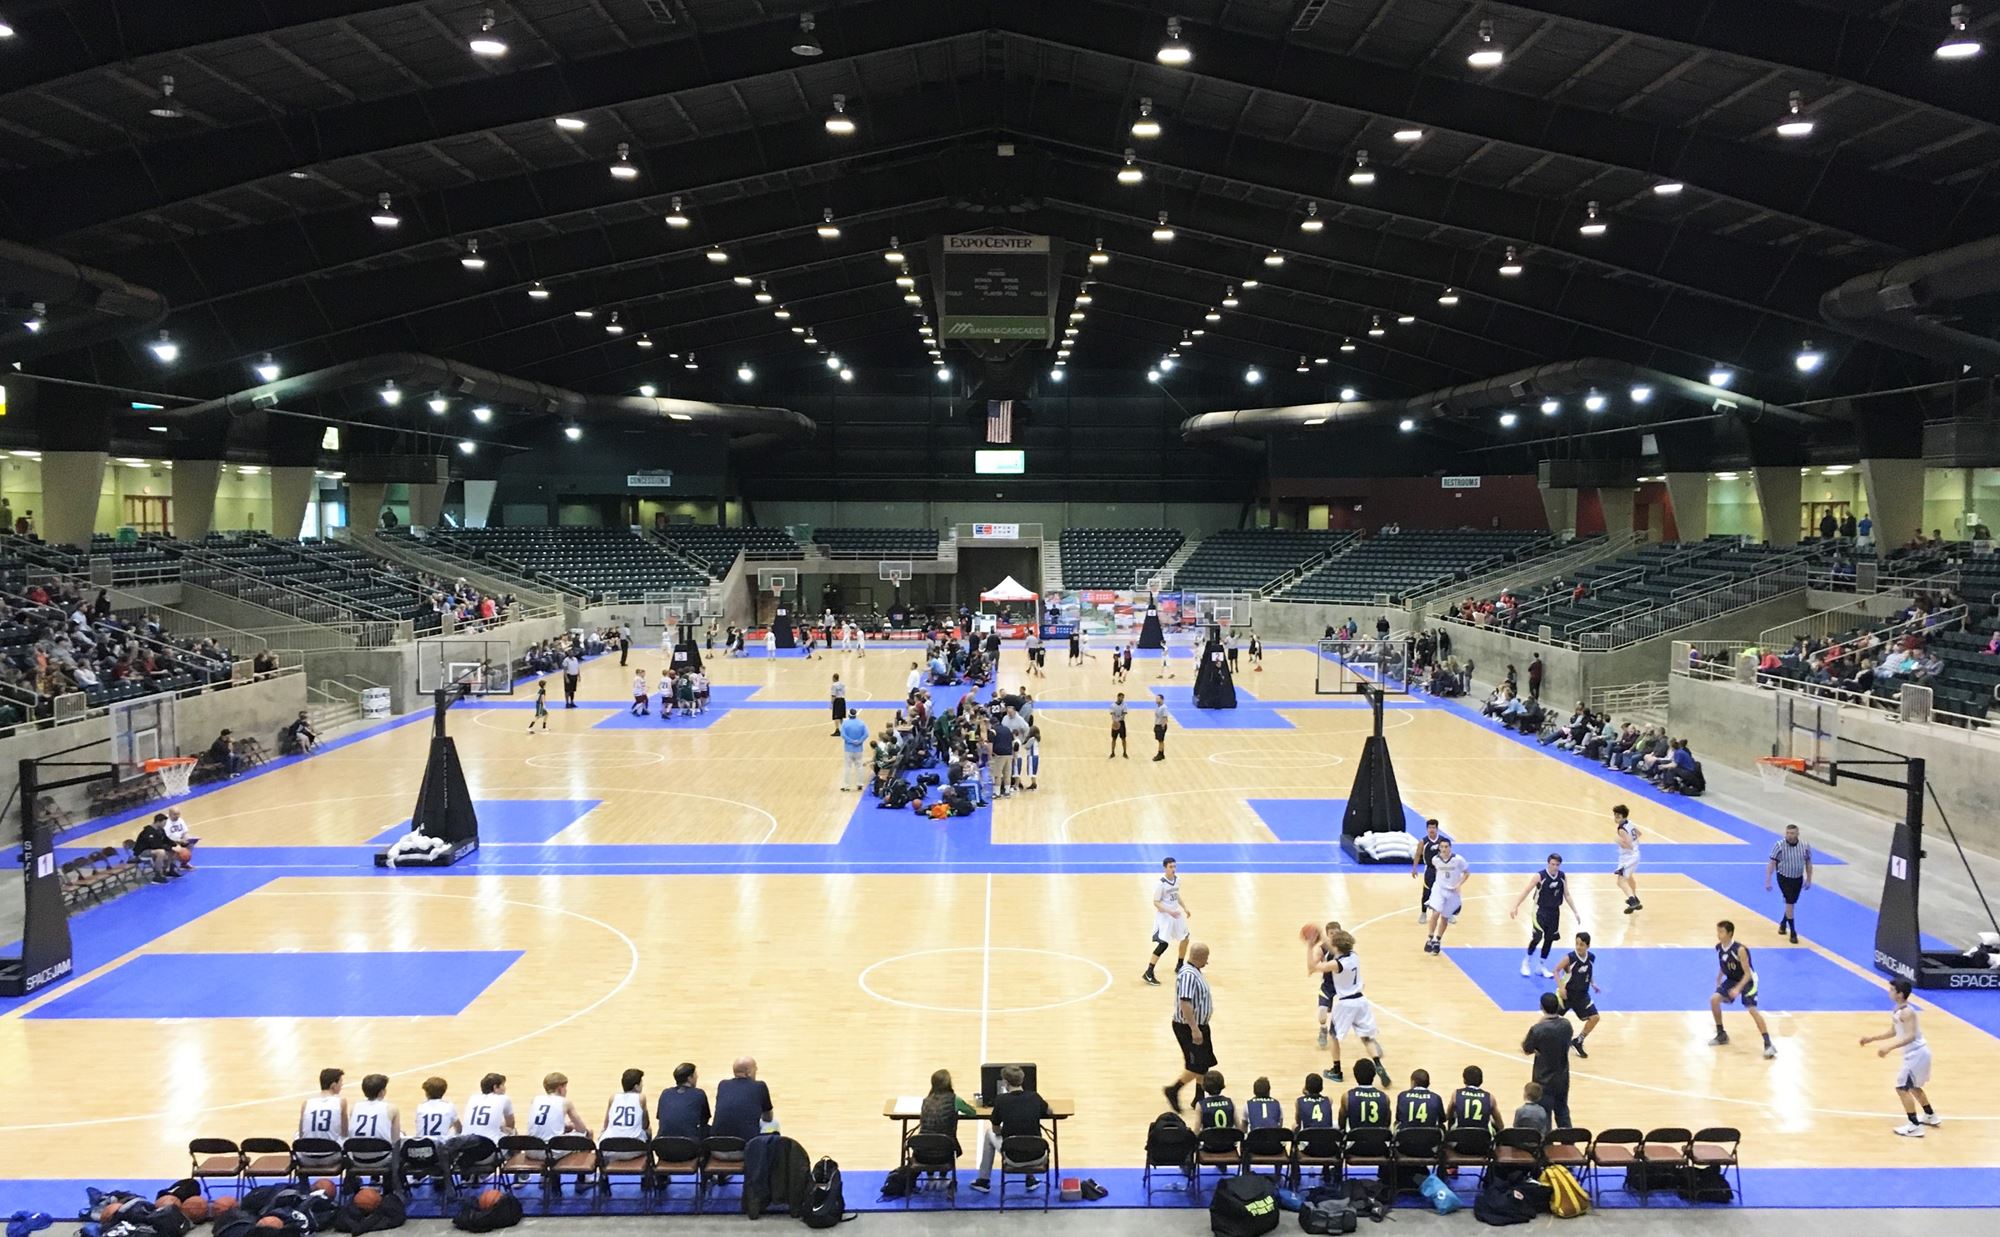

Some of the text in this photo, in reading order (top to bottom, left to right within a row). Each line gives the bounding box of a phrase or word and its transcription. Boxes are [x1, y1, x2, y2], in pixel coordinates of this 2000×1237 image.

[950, 237, 1032, 249] EXPO CENTER
[1443, 477, 1478, 487] RESTROOMS
[42, 856, 48, 875] 1
[1896, 858, 1902, 878] 1
[1350, 967, 1358, 986] 7
[1949, 974, 2000, 988] SPACE
[1355, 1090, 1381, 1098] EAGLES
[470, 1105, 491, 1126] 15
[534, 1104, 551, 1126] 3
[612, 1106, 635, 1127] 26
[1214, 1108, 1228, 1128] 0
[1261, 1103, 1268, 1119] 1
[1311, 1104, 1324, 1122] 4
[1360, 1101, 1379, 1124] 13
[1408, 1101, 1428, 1124] 14
[1464, 1098, 1483, 1121] 12
[310, 1109, 332, 1132] 13
[354, 1113, 378, 1137] 21
[422, 1113, 443, 1136] 12
